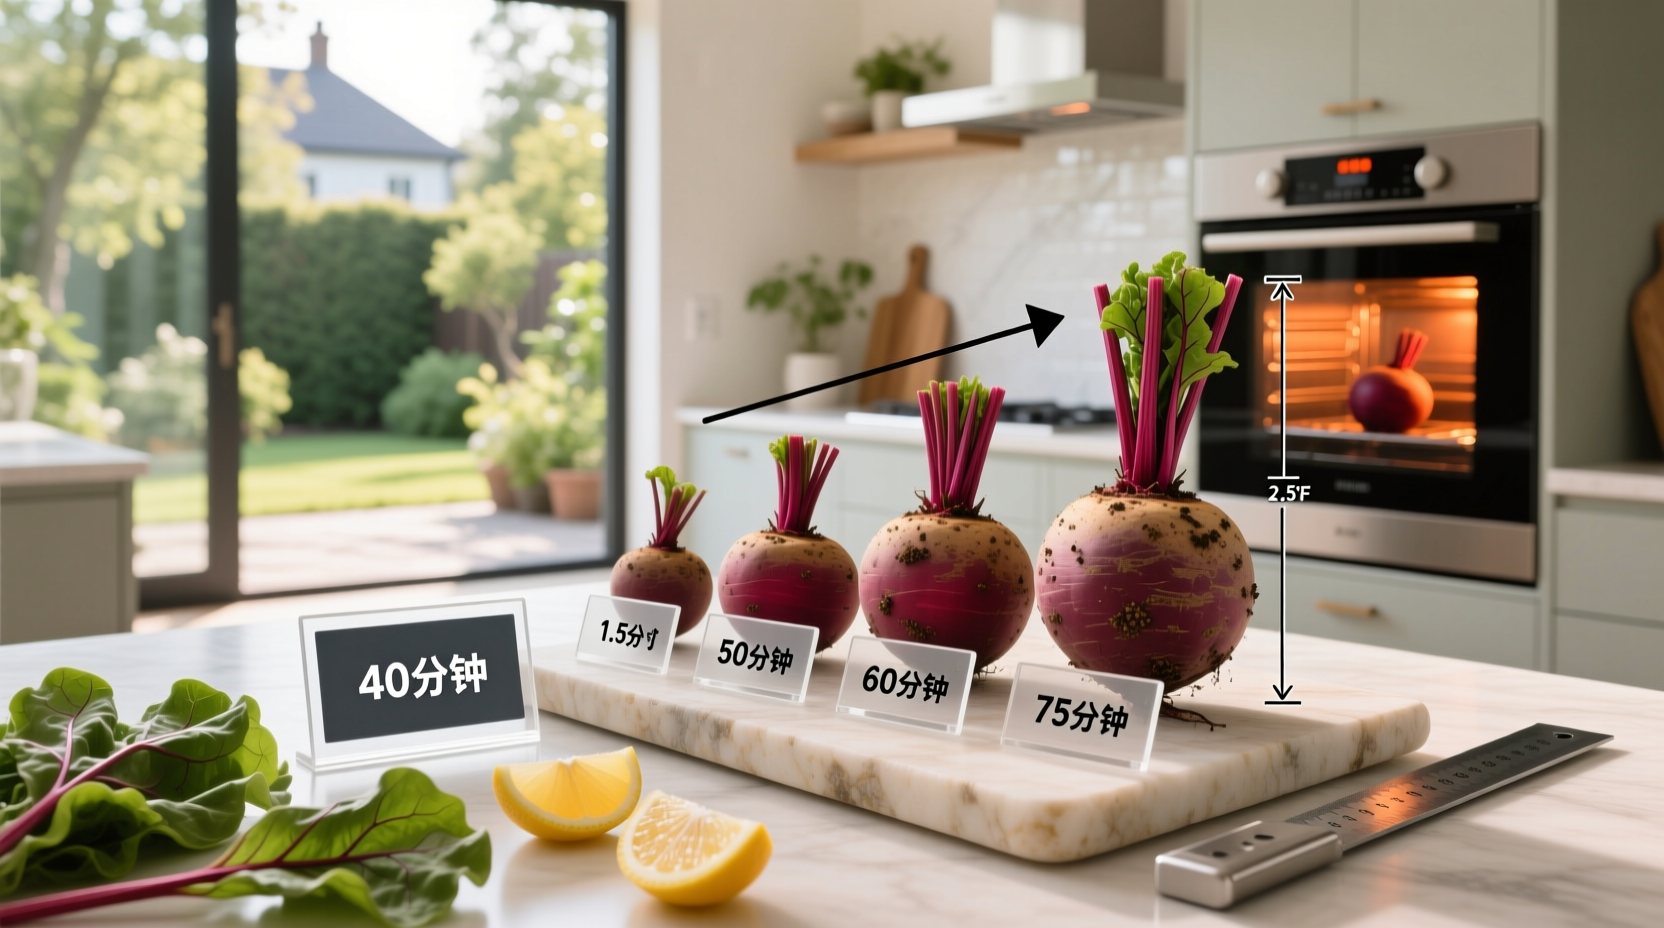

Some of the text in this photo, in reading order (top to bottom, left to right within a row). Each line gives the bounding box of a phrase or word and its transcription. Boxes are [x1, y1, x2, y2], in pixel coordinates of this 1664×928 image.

[358, 652, 488, 700] 40分钟
[717, 638, 794, 676] 50分钟
[862, 665, 950, 704] 60分钟
[1035, 694, 1129, 738] 75分钟
